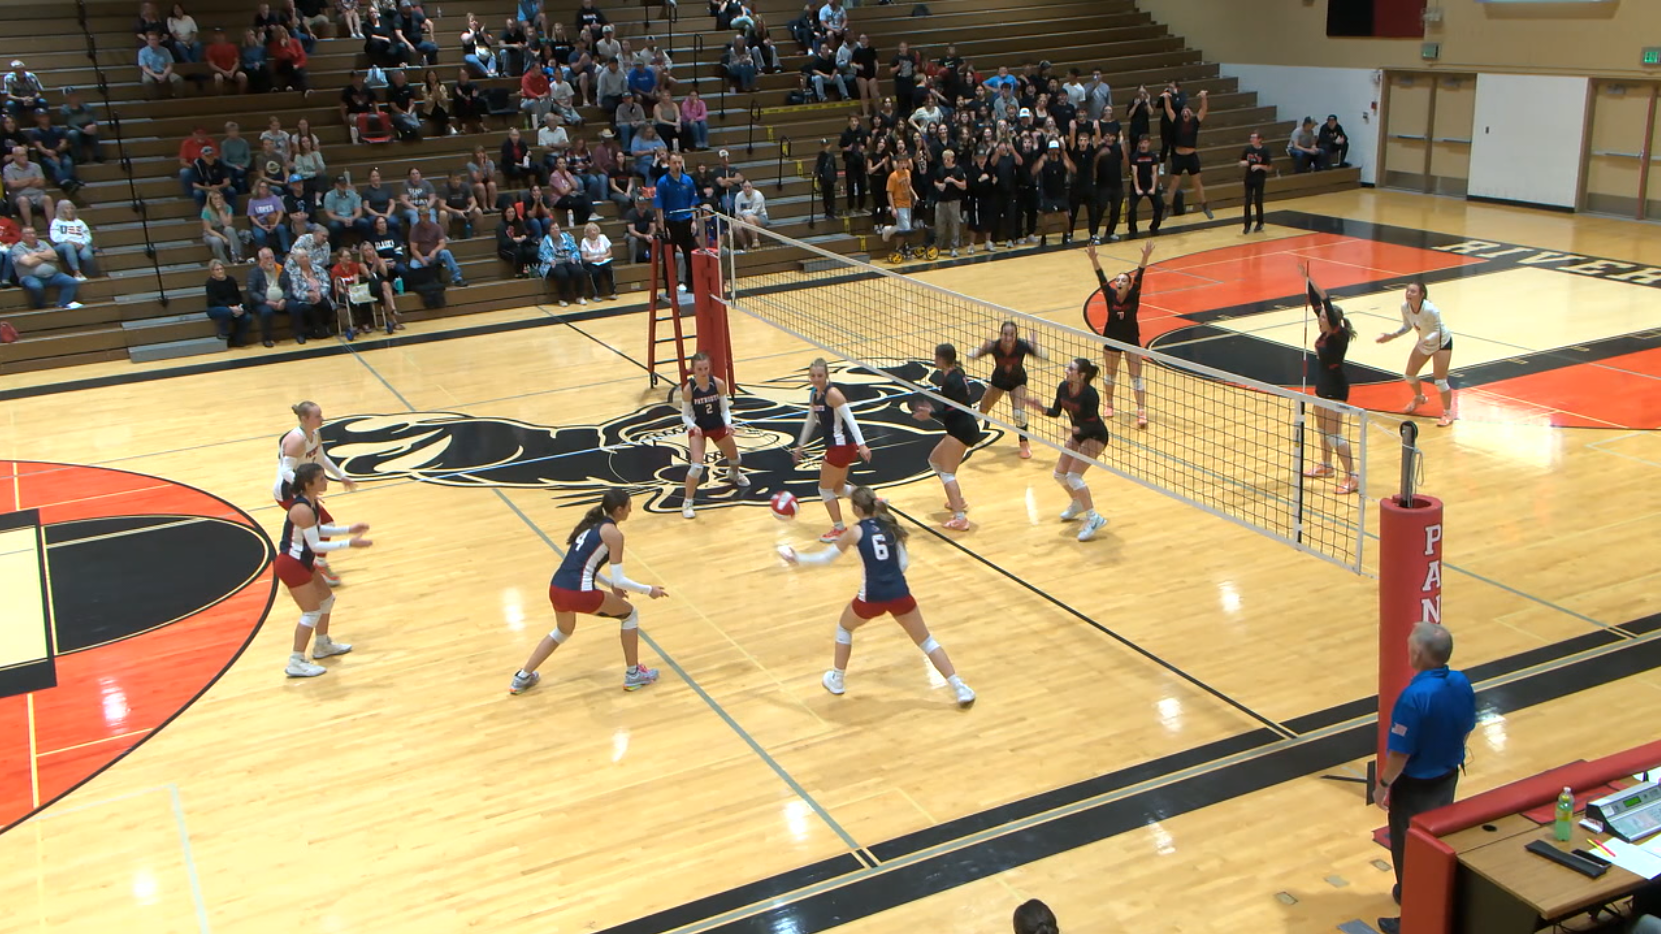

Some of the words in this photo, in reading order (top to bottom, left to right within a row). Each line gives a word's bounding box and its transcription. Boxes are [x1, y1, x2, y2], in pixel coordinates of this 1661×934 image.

[705, 403, 714, 415] 2
[574, 530, 590, 551] 4
[871, 533, 890, 561] 6
